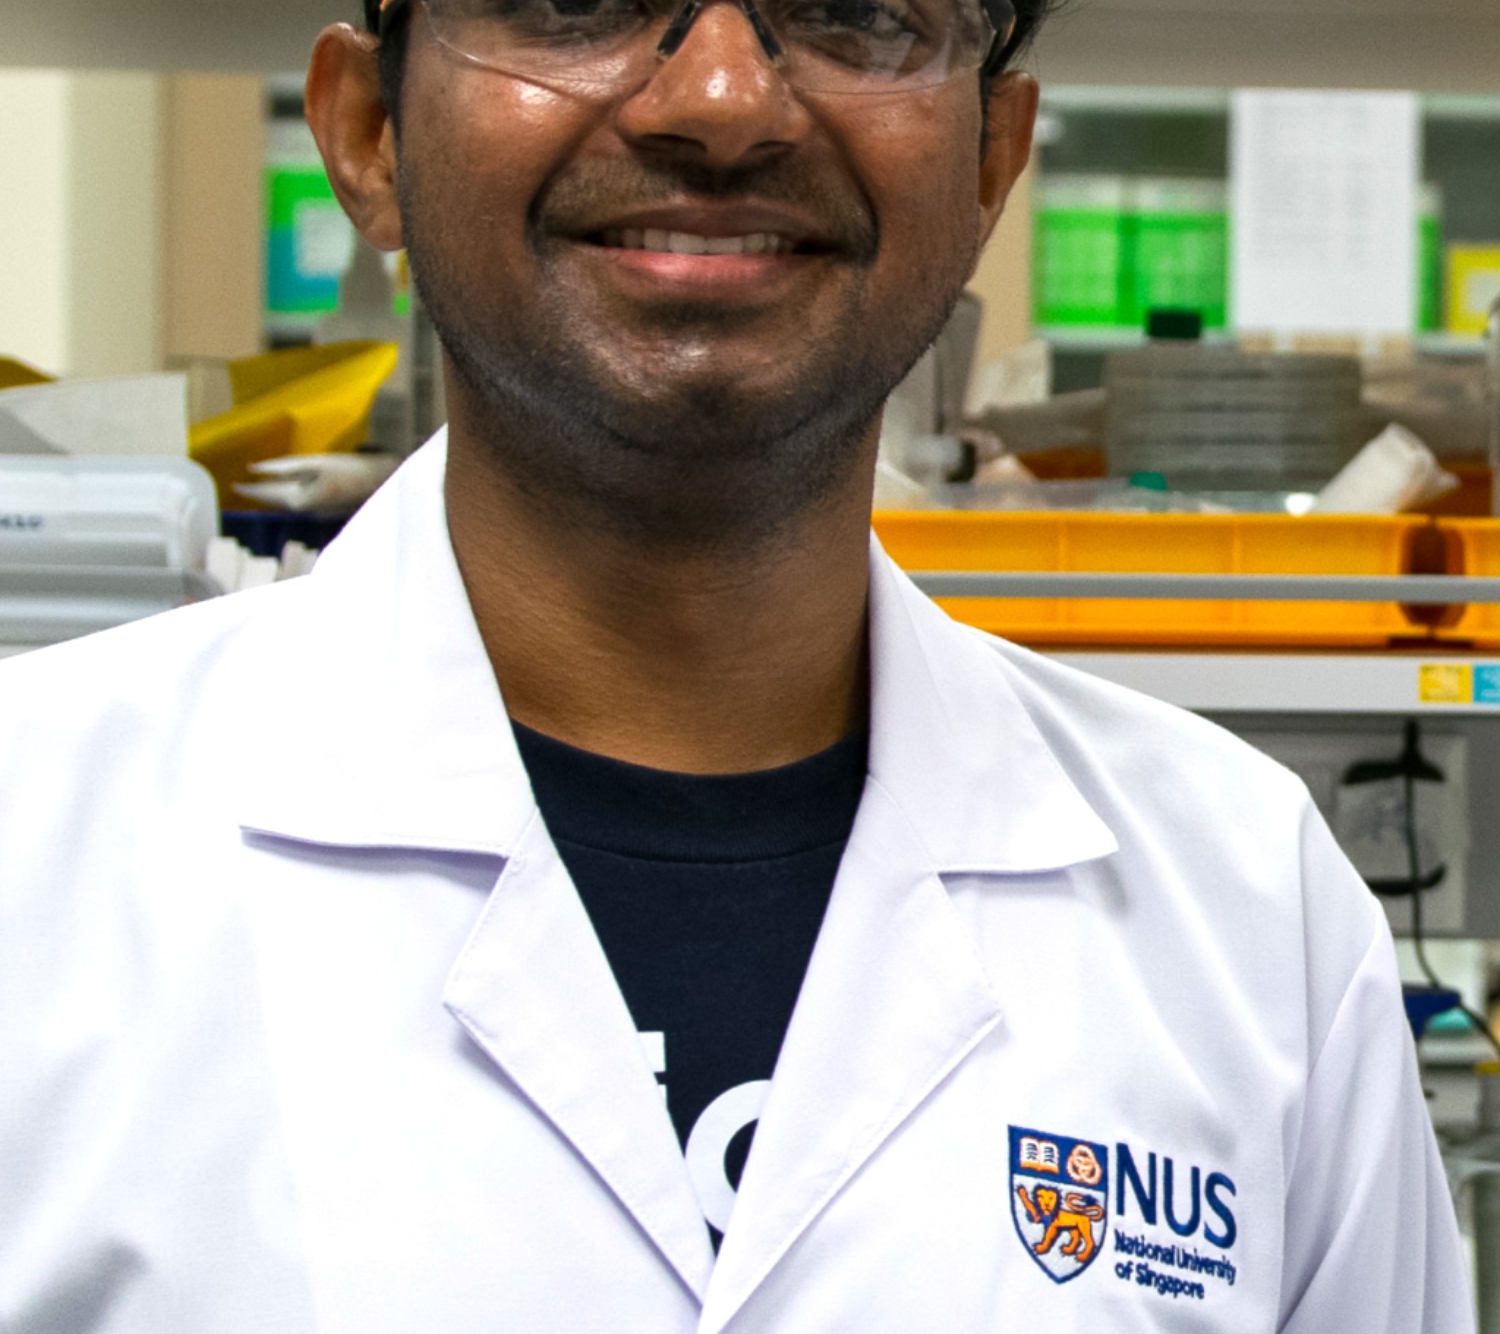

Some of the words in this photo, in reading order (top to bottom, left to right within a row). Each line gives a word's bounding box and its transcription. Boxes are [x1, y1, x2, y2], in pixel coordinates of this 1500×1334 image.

[1115, 1142, 1238, 1249] NUS
[1113, 1227, 1176, 1266] National
[1175, 1244, 1237, 1287] University
[1113, 1260, 1134, 1281] of
[1134, 1263, 1206, 1300] Singapore
